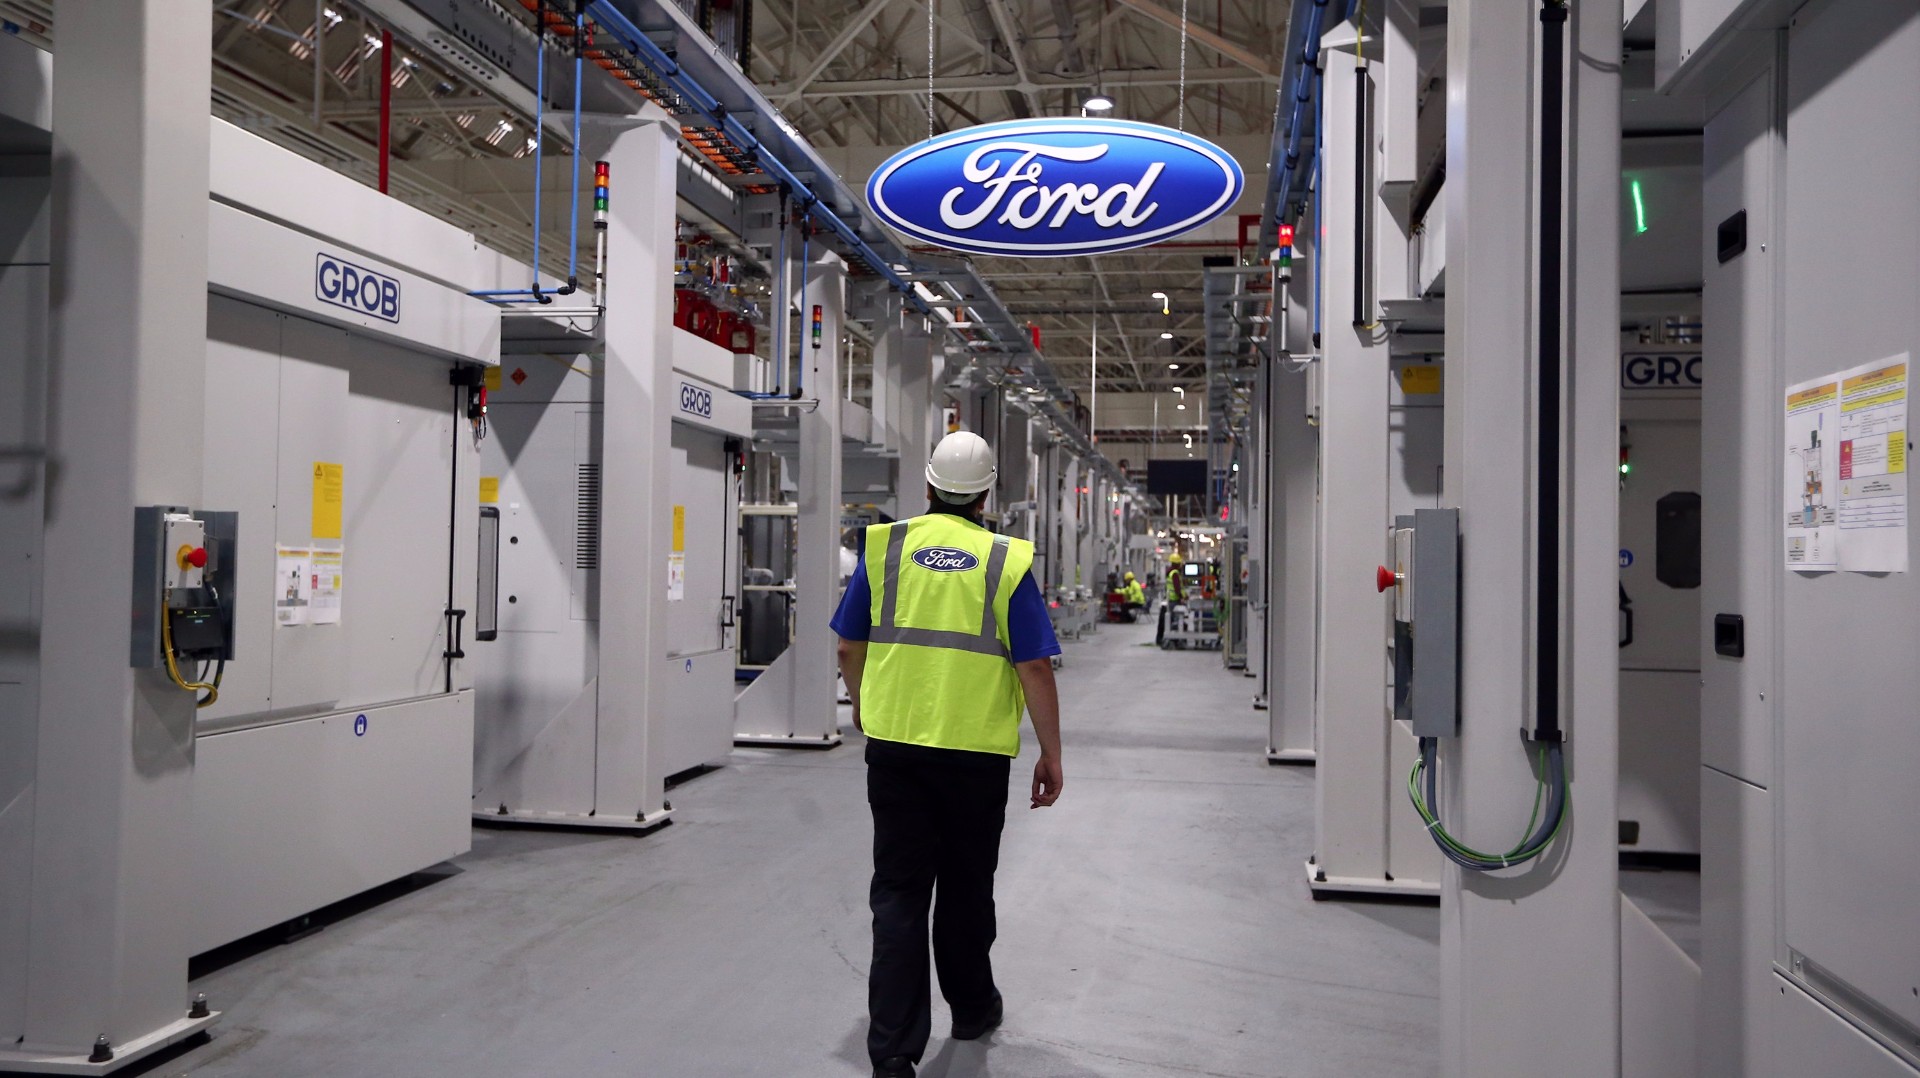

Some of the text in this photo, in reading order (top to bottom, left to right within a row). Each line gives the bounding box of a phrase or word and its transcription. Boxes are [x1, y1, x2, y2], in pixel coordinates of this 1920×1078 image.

[939, 142, 1165, 229] Ford
[319, 261, 397, 318] GROB
[1626, 356, 1702, 385] GRO
[681, 386, 711, 416] GROB
[924, 549, 966, 568] Ford
